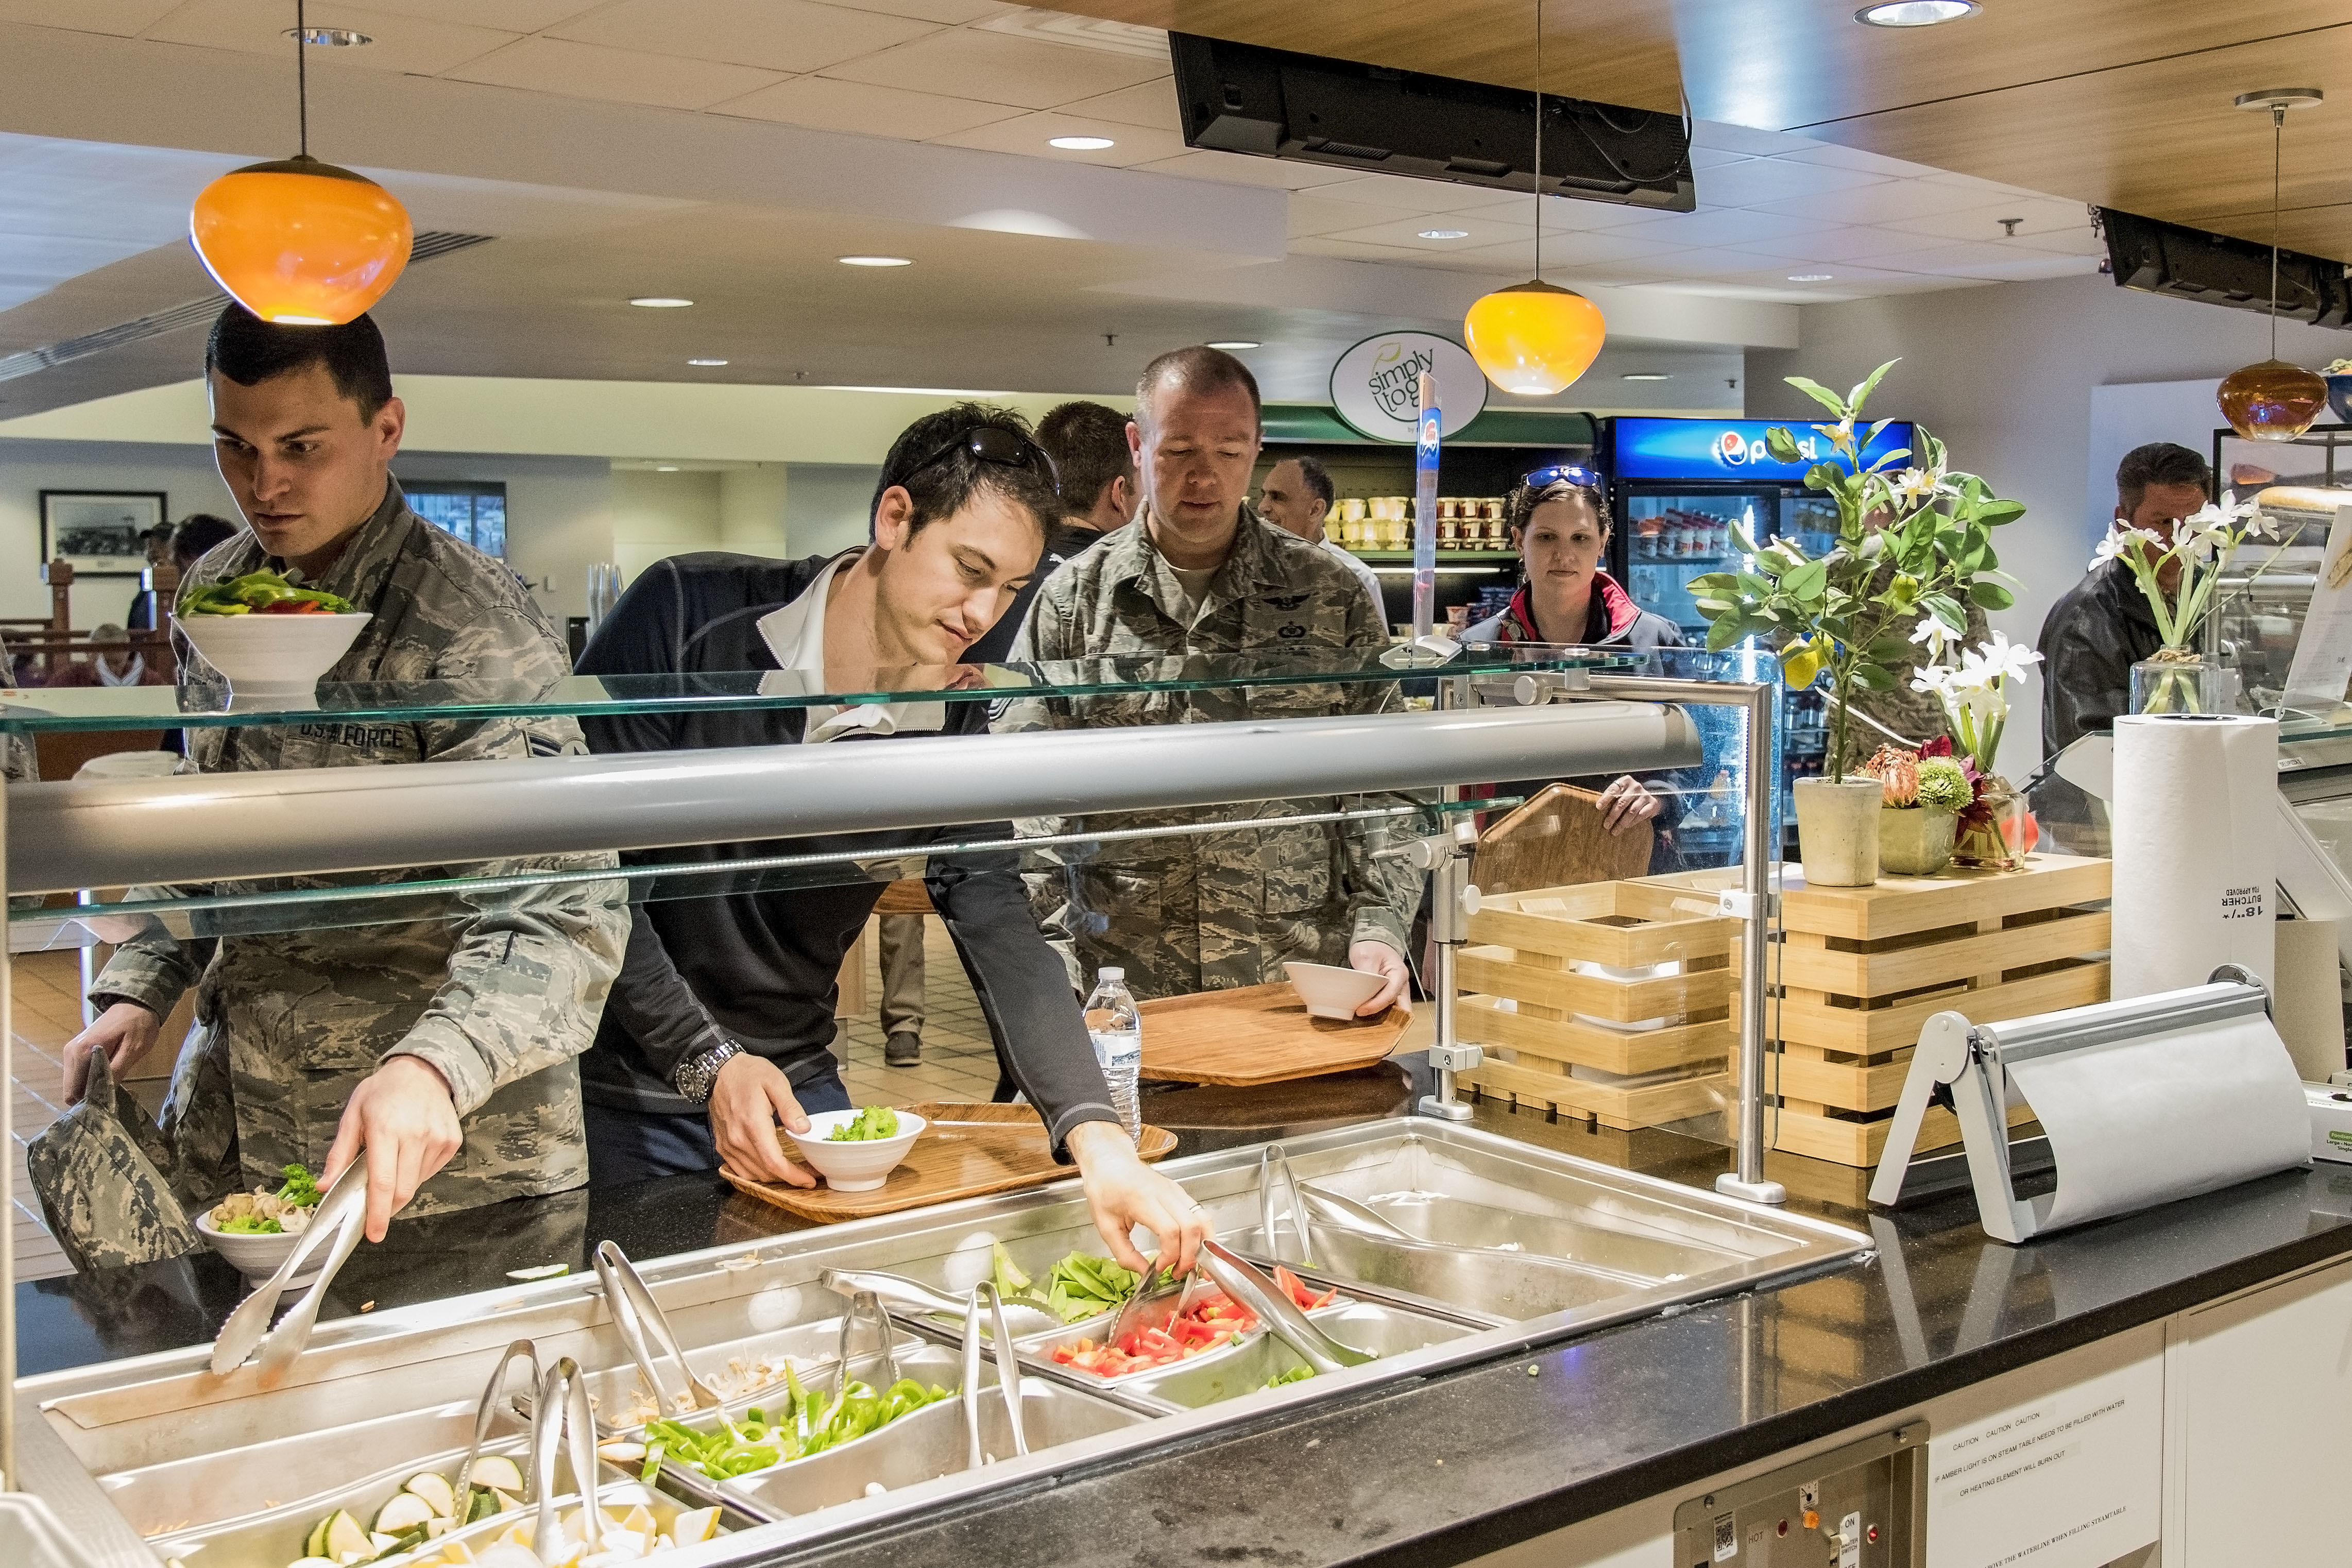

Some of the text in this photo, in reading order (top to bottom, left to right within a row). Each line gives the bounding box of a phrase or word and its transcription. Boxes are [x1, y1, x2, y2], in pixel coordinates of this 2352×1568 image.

[1368, 348, 1434, 395] simply
[1750, 436, 1818, 464] psi
[344, 725, 403, 747] FORCE
[2221, 894, 2261, 906] BUTCHER
[2226, 887, 2251, 896] APPROVED
[1934, 1475, 1940, 1484] IF
[1941, 1467, 1963, 1480] AMBER
[1963, 1460, 1980, 1472] LIGHT
[1988, 1453, 1997, 1462] ON
[1998, 1445, 2017, 1458] STEAM
[2018, 1437, 2036, 1449] TABLE
[2036, 1428, 2055, 1441] NEEDS
[2065, 1421, 2072, 1429] BE
[2073, 1413, 2091, 1426] FILLED
[2092, 1408, 2106, 1418] WITH
[2106, 1399, 2125, 1411] WATER
[1952, 1412, 2040, 1451] CAUTION CAUTION CAUTION
[1959, 1450, 2065, 1497] OR HEATING ELEMENT WILL BURN OUT
[1845, 1517, 1855, 1528] ON
[1748, 1530, 1764, 1544] HOT
[1984, 1505, 2127, 1568] BOVE THE WATERLINE WHEN FILLING STEAMTABLE
[1841, 1545, 1858, 1556] SWITCH
